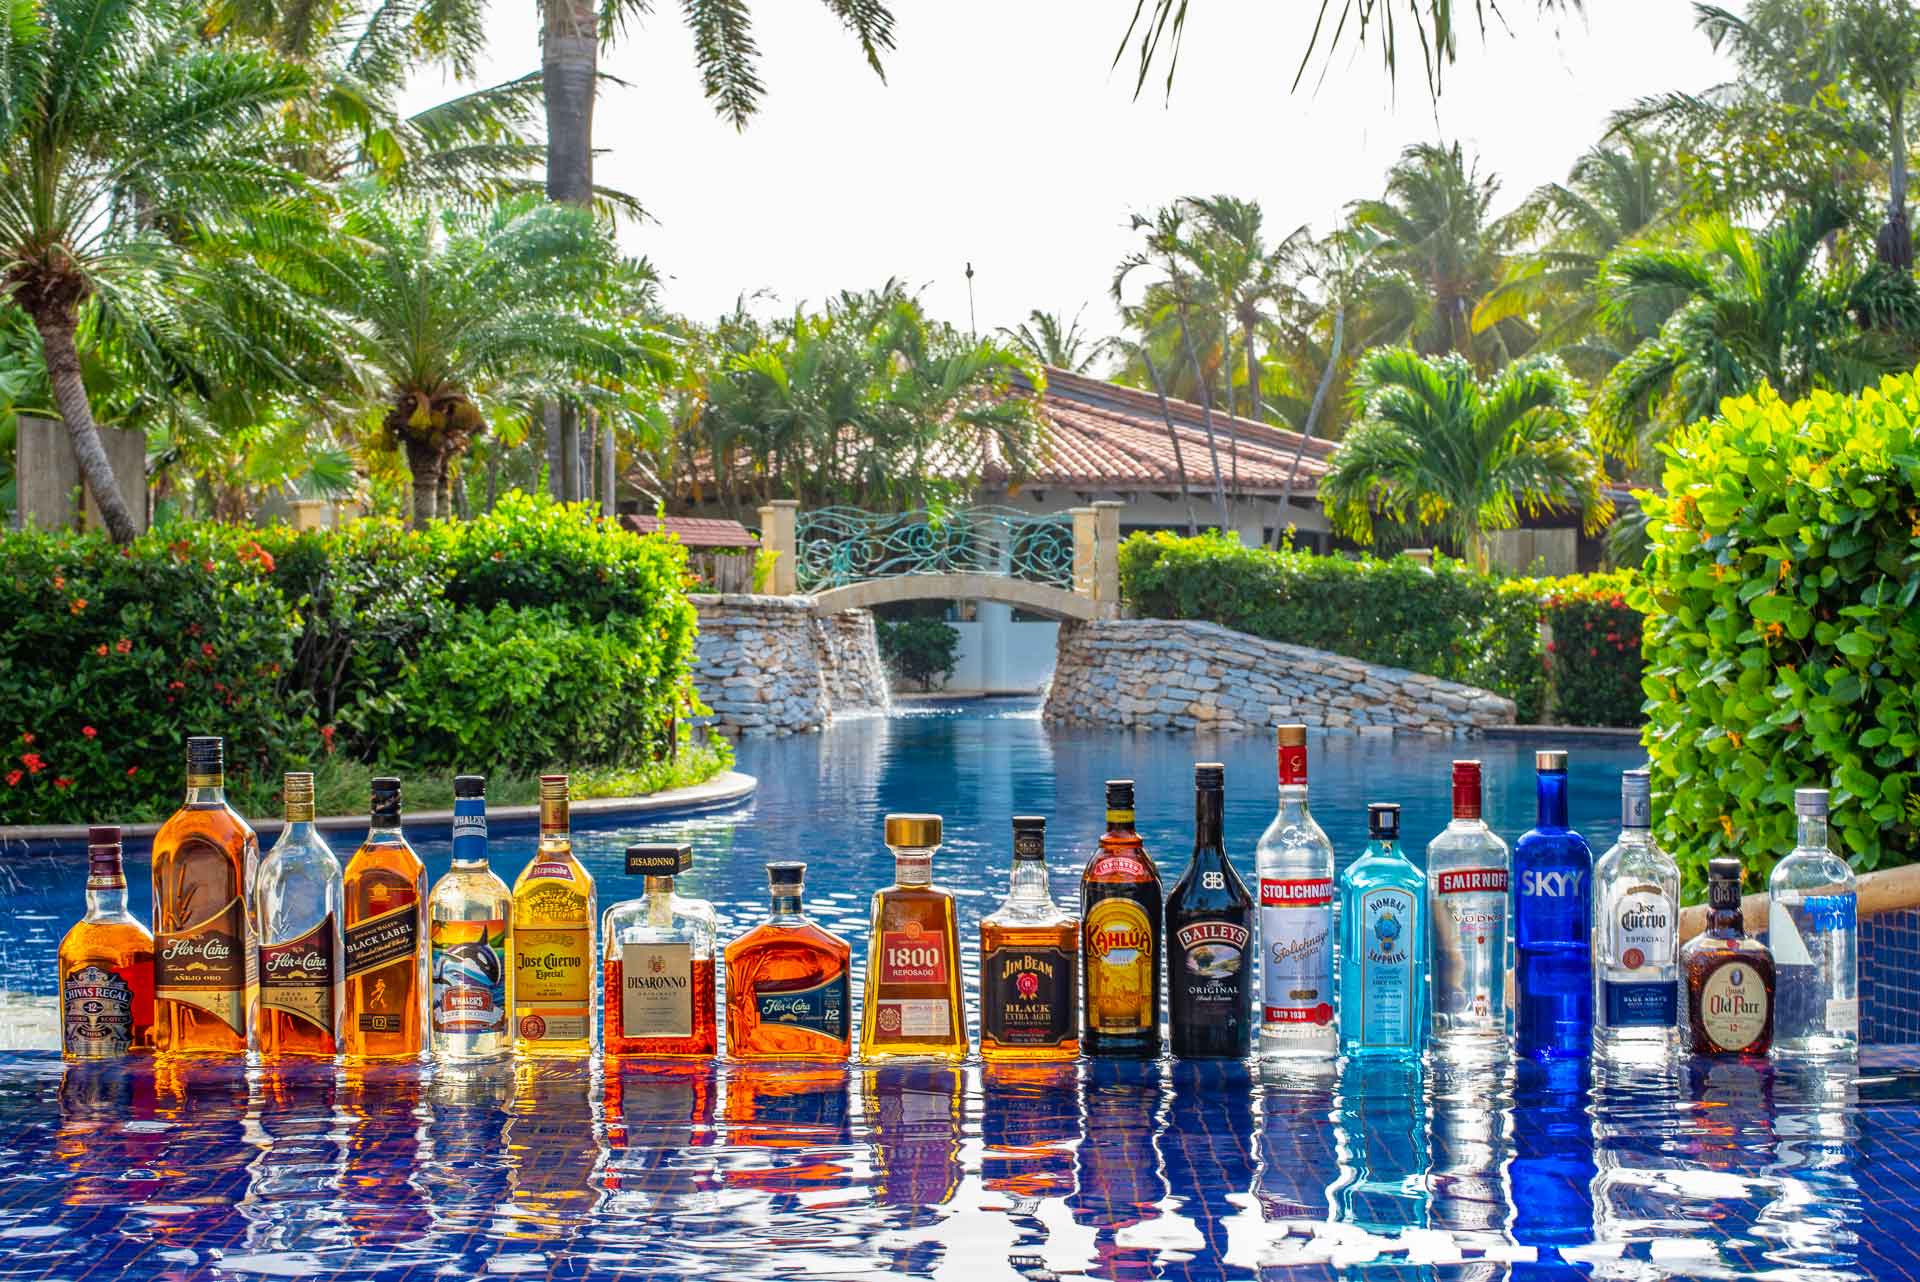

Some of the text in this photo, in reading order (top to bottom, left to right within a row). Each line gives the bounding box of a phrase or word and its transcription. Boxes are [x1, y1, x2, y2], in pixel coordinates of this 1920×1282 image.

[630, 857, 675, 867] DISARONNO
[1521, 870, 1584, 897] SKYY
[1369, 897, 1406, 914] BOMBAY
[1451, 912, 1504, 922] VODKA
[1621, 909, 1666, 932] Cuervo
[346, 924, 412, 953] BLACK LABEL
[1086, 922, 1152, 957] KAHLÚA
[1182, 925, 1246, 945] BAILEYS
[162, 938, 231, 960] Flor de Caña
[888, 947, 939, 967] 1800
[266, 952, 294, 972] Flor
[302, 951, 327, 971] Caña
[517, 952, 581, 970] Jose Cuervo
[1002, 955, 1053, 979] JIM BEAM
[627, 976, 687, 990] DISARONNO
[1188, 986, 1239, 994] ORIGINAL
[65, 987, 129, 1002] CHIVAS REGAL
[314, 991, 325, 1004] 7
[762, 998, 785, 1015] Flor
[791, 998, 811, 1014] Caña
[1006, 1003, 1049, 1013] BLACK
[1711, 994, 1761, 1016] Old Parr
[824, 1009, 840, 1020] 12
[1729, 1023, 1738, 1033] 12
